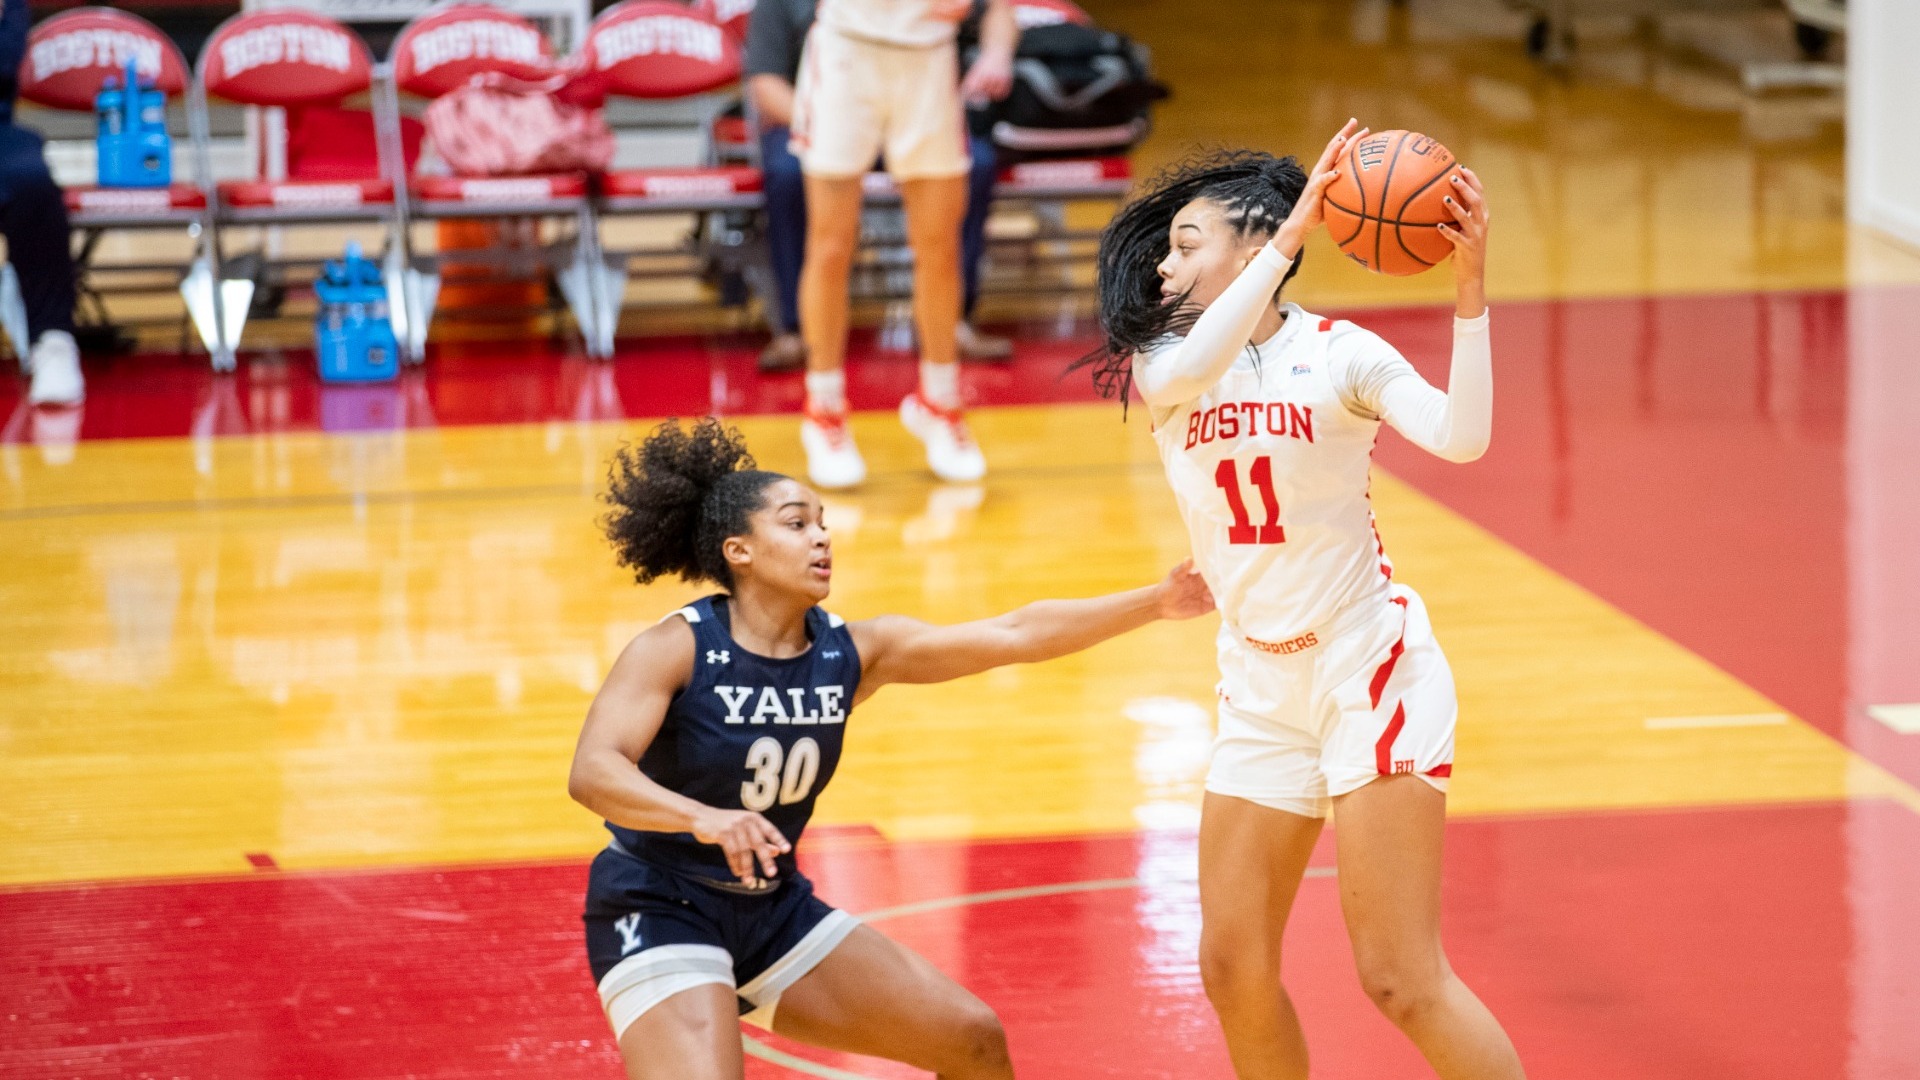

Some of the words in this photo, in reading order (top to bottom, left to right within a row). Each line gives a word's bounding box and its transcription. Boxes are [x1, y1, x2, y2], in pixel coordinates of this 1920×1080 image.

[32, 28, 162, 80] BOSTON
[222, 23, 350, 79] BOSTON
[412, 19, 540, 75] BOSTON
[595, 14, 723, 70] BOSTON
[1184, 402, 1314, 451] BOSTON
[1214, 456, 1287, 545] 11
[713, 685, 846, 725] YALE
[740, 736, 821, 812] 30
[614, 912, 642, 956] Y
